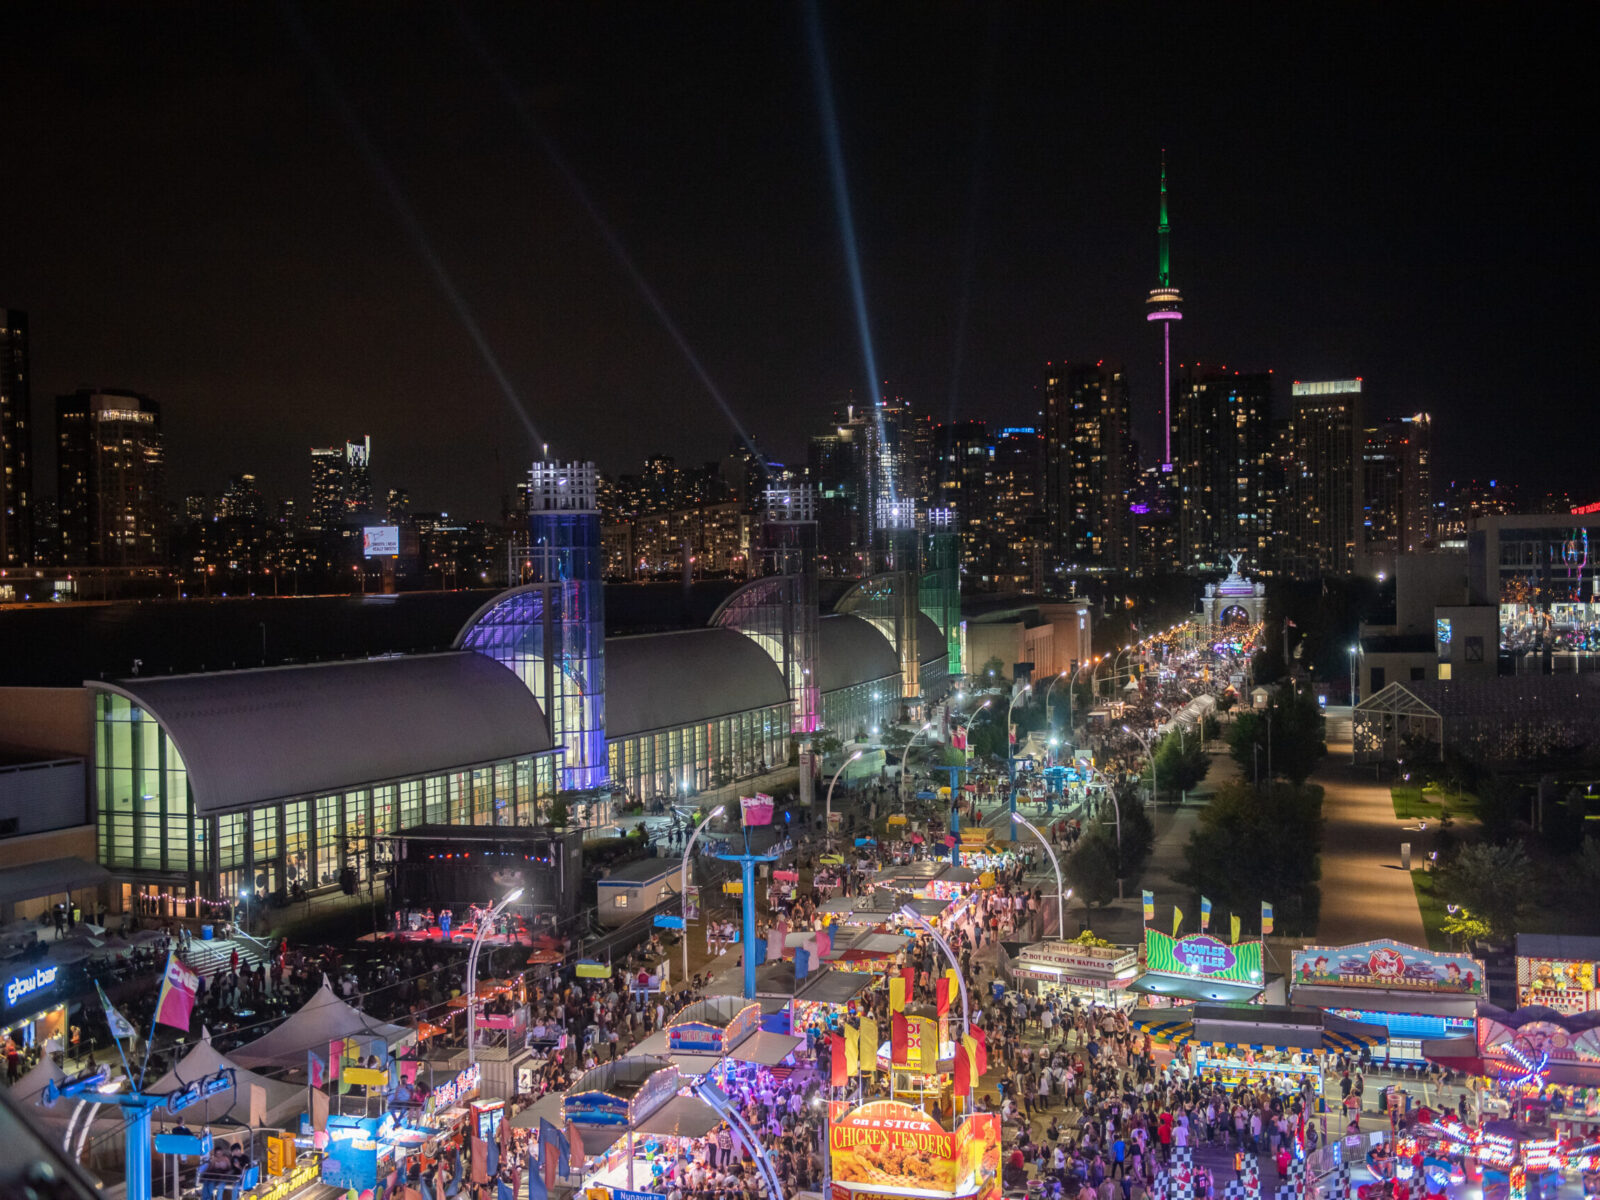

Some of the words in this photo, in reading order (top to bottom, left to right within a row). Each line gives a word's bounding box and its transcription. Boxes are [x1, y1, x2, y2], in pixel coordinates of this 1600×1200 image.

[1182, 943, 1225, 957] BOWLER
[1054, 956, 1075, 964] CREAM
[1077, 959, 1105, 968] WAFFLES
[1186, 953, 1226, 968] ROLLER
[167, 962, 199, 992] CNE
[1029, 971, 1055, 980] CREAM
[1065, 976, 1101, 986] WAFFLES
[1339, 974, 1375, 984] FIRE
[1381, 977, 1437, 987] HOUSE
[8, 976, 36, 1004] glow
[37, 967, 58, 987] bar
[884, 1119, 931, 1131] STICK
[834, 1126, 889, 1149] CHICKEN
[892, 1131, 952, 1160] TENDERS
